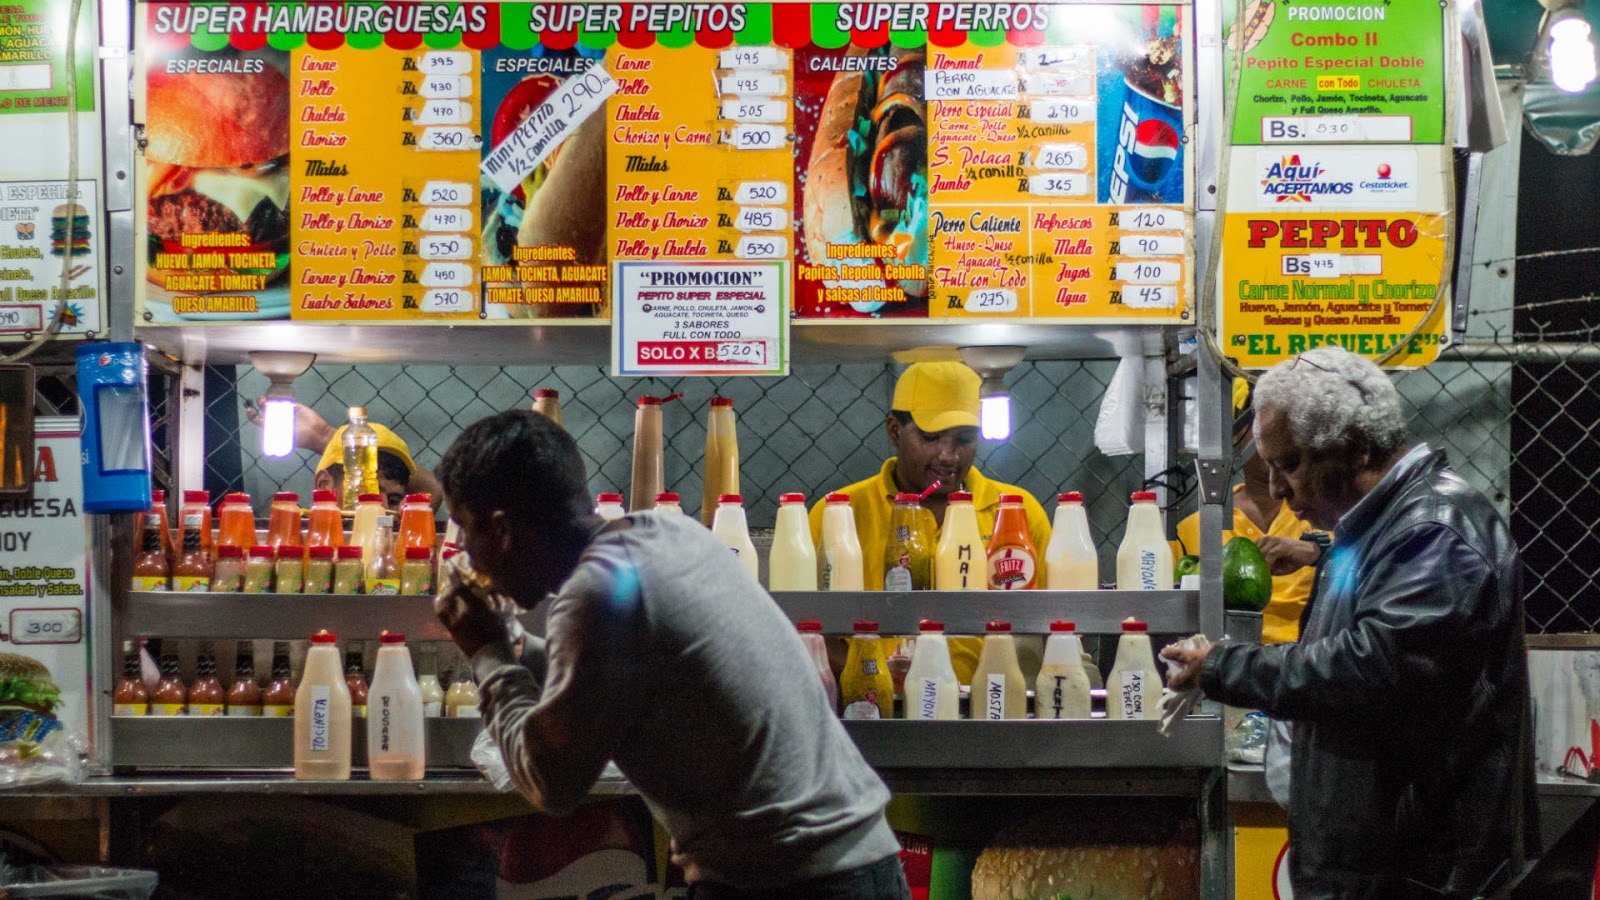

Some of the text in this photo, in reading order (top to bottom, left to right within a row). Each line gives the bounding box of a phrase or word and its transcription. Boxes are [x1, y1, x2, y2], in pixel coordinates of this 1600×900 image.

[154, 4, 488, 34] SUPER HAMBURGUESAS
[529, 3, 747, 33] SUPER PEPITOS
[836, 3, 1050, 32] SUPER PERROS
[1290, 32, 1359, 47] Combo
[165, 58, 265, 74] ESPECIALES
[300, 55, 337, 72] Carne
[430, 56, 454, 67] 395
[495, 57, 595, 73] ESPECIALES
[614, 54, 652, 71] Carne
[734, 52, 760, 65] 495
[809, 56, 898, 72] CALIENTES
[932, 53, 984, 71] Normal
[1246, 56, 1426, 71] Pepito Especial Doble
[737, 79, 759, 92] 495
[935, 70, 976, 85] PERRO
[1266, 78, 1421, 89] CARNE con Todo CHULETA
[300, 78, 336, 97] Pollo
[430, 81, 453, 92] 430
[614, 77, 651, 96] Pollo
[935, 85, 961, 98] CON
[561, 72, 604, 120] 290
[300, 105, 347, 123] Chuleta
[614, 104, 661, 122] Chuleta
[737, 104, 765, 118] 505
[930, 99, 1013, 122] Perro Especial
[1300, 106, 1343, 115] Full Queso
[939, 119, 1007, 132] Carne Pollo
[1270, 120, 1306, 138] Bs.
[300, 130, 348, 147] Chorizo
[432, 131, 463, 146] 360
[613, 125, 712, 144] Chorizo Carne
[741, 130, 771, 146] 500
[958, 146, 1011, 169] Polaca
[1265, 162, 1321, 182] Aquí
[929, 174, 972, 194] Jumbo
[1263, 182, 1354, 195] ACEPTAMOS
[300, 185, 384, 203] Pollo Carne
[431, 189, 459, 202] 520
[615, 185, 699, 202] Pollo Carne
[749, 186, 777, 199] 520
[300, 213, 394, 231] Pollo Chorizo
[615, 212, 710, 229] Pollo Chorizo
[743, 211, 773, 227] 485
[931, 210, 1021, 238] Perro Caliente
[1034, 213, 1094, 233] Refrescos
[1133, 212, 1166, 228] 120
[180, 231, 252, 249] Ingredientes:
[1247, 219, 1419, 248] PEPITO
[298, 240, 397, 260] Chuleta Pollo
[429, 240, 460, 256] 530
[512, 244, 577, 262] Ingredientes:
[615, 240, 709, 257] Pollo Chuleta
[746, 243, 775, 256] 530
[825, 242, 897, 260] Ingredientes:
[1054, 239, 1094, 256] Malta
[1138, 239, 1159, 252] 90
[228, 252, 277, 269] TOCINETA
[301, 268, 396, 286] Carne Chorizo
[561, 266, 608, 282] AGUACATE
[885, 263, 926, 280] Cebolla
[934, 266, 1027, 288] Full con Todo
[1055, 262, 1092, 283] Jugos
[1133, 264, 1161, 279] 100
[219, 275, 258, 291] TOMATE
[1239, 279, 1437, 300] Carne Normal Chorizo
[301, 293, 394, 311] Cuatro Sabores
[434, 292, 459, 306] 570
[525, 287, 555, 303] QUESO
[556, 287, 602, 303] AMARILLO.
[637, 291, 766, 301] PEPITO SUPER ESPECIAL
[825, 286, 907, 302] salsas al Gusto.
[1055, 288, 1088, 307] Agua
[1139, 287, 1162, 302] 45
[173, 296, 259, 314] QUESO AMARILLO.
[1240, 302, 1382, 315] Huevo, Jamón, Aguacate
[674, 321, 730, 329] 3 SABORES
[1263, 314, 1401, 326] Salsas Queso Amarillo
[662, 331, 741, 339] FULL CON TODO
[640, 347, 701, 361] SOLO X
[13, 566, 74, 581] Doble Queso
[1000, 559, 1020, 574] FRITZ
[27, 622, 63, 634] 300
